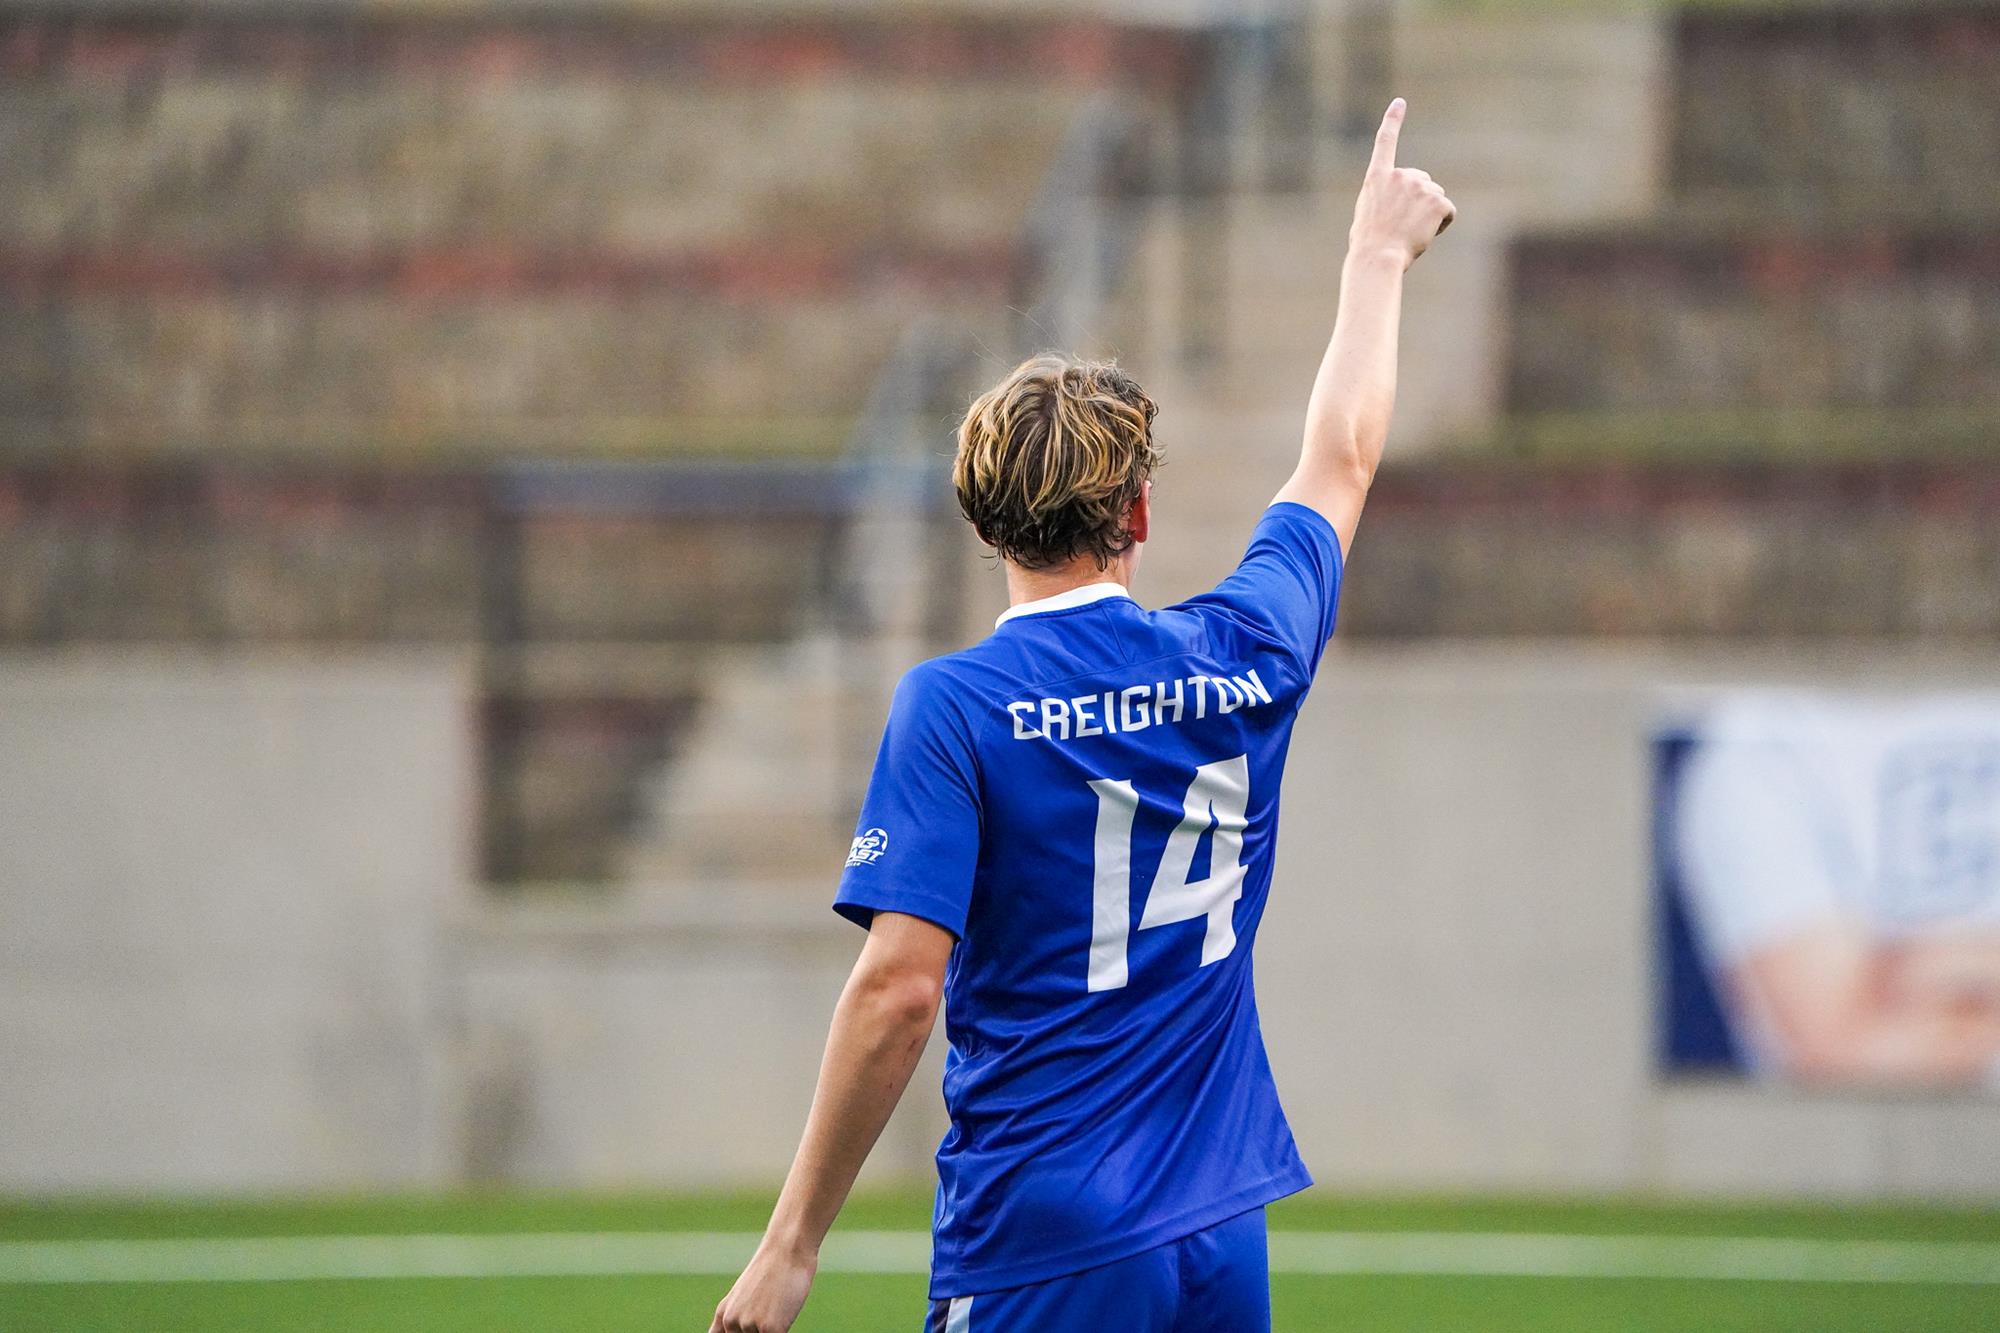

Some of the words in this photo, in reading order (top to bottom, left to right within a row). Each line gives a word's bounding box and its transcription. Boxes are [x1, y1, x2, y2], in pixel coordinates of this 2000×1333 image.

[1007, 669, 1273, 740] CREIGHTON
[847, 847, 885, 862] AST
[1087, 753, 1249, 993] 14
